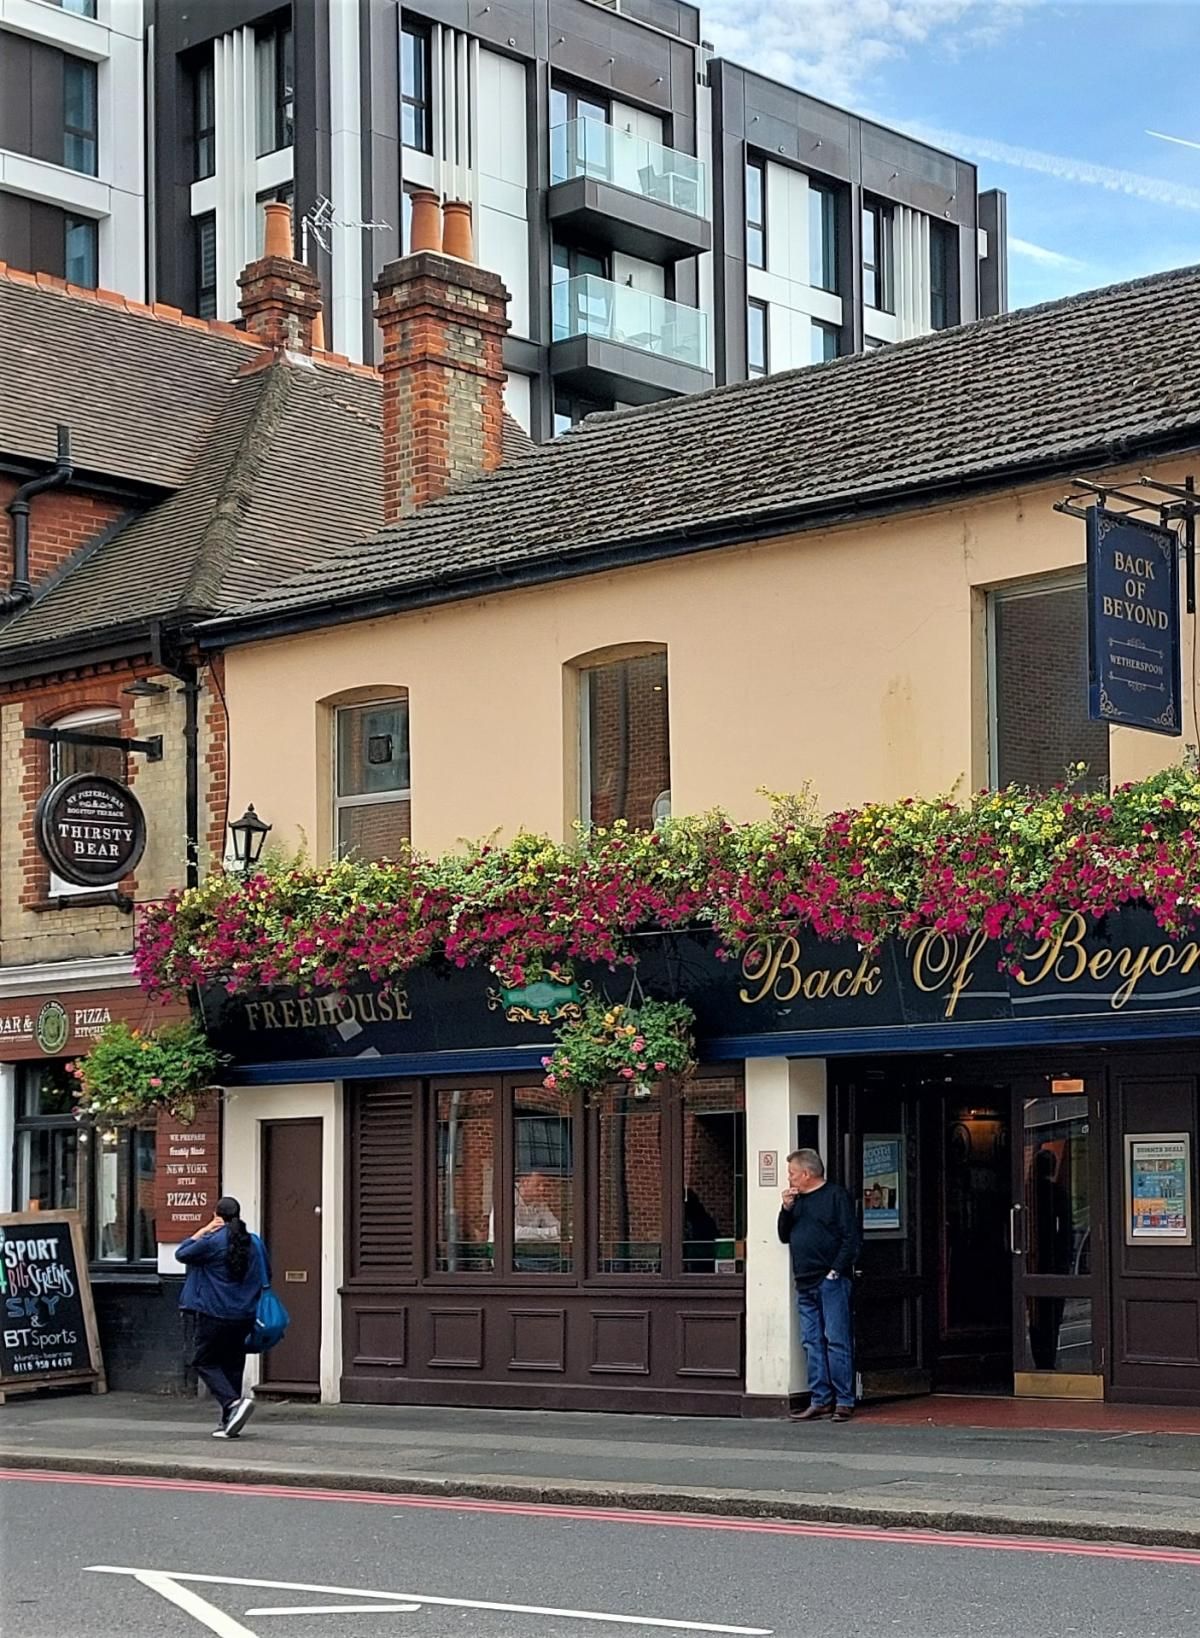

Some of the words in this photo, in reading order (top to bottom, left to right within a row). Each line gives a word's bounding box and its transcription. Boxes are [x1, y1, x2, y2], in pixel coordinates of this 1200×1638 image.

[1114, 551, 1155, 580] BACK
[1125, 579, 1146, 600] OF
[1103, 596, 1168, 631] BEYOND
[1109, 654, 1164, 676] WETHERSPOON
[58, 824, 133, 841] THIRSTY
[74, 840, 119, 856] BEAR
[740, 932, 883, 1003] Back
[906, 925, 988, 1017] Of
[23, 1014, 33, 1031] &
[75, 1008, 111, 1025] PIZZA
[245, 990, 412, 1030] FREEHOUSE
[74, 1025, 105, 1037] KITCHE
[166, 1164, 185, 1174] NEW
[186, 1163, 208, 1174] YORK
[167, 1192, 207, 1206] PIZZA'S
[4, 1238, 59, 1268] SPORT
[8, 1262, 29, 1297] BIG
[27, 1263, 74, 1297] SCREENS
[6, 1295, 59, 1317] SKY
[31, 1315, 48, 1327] &
